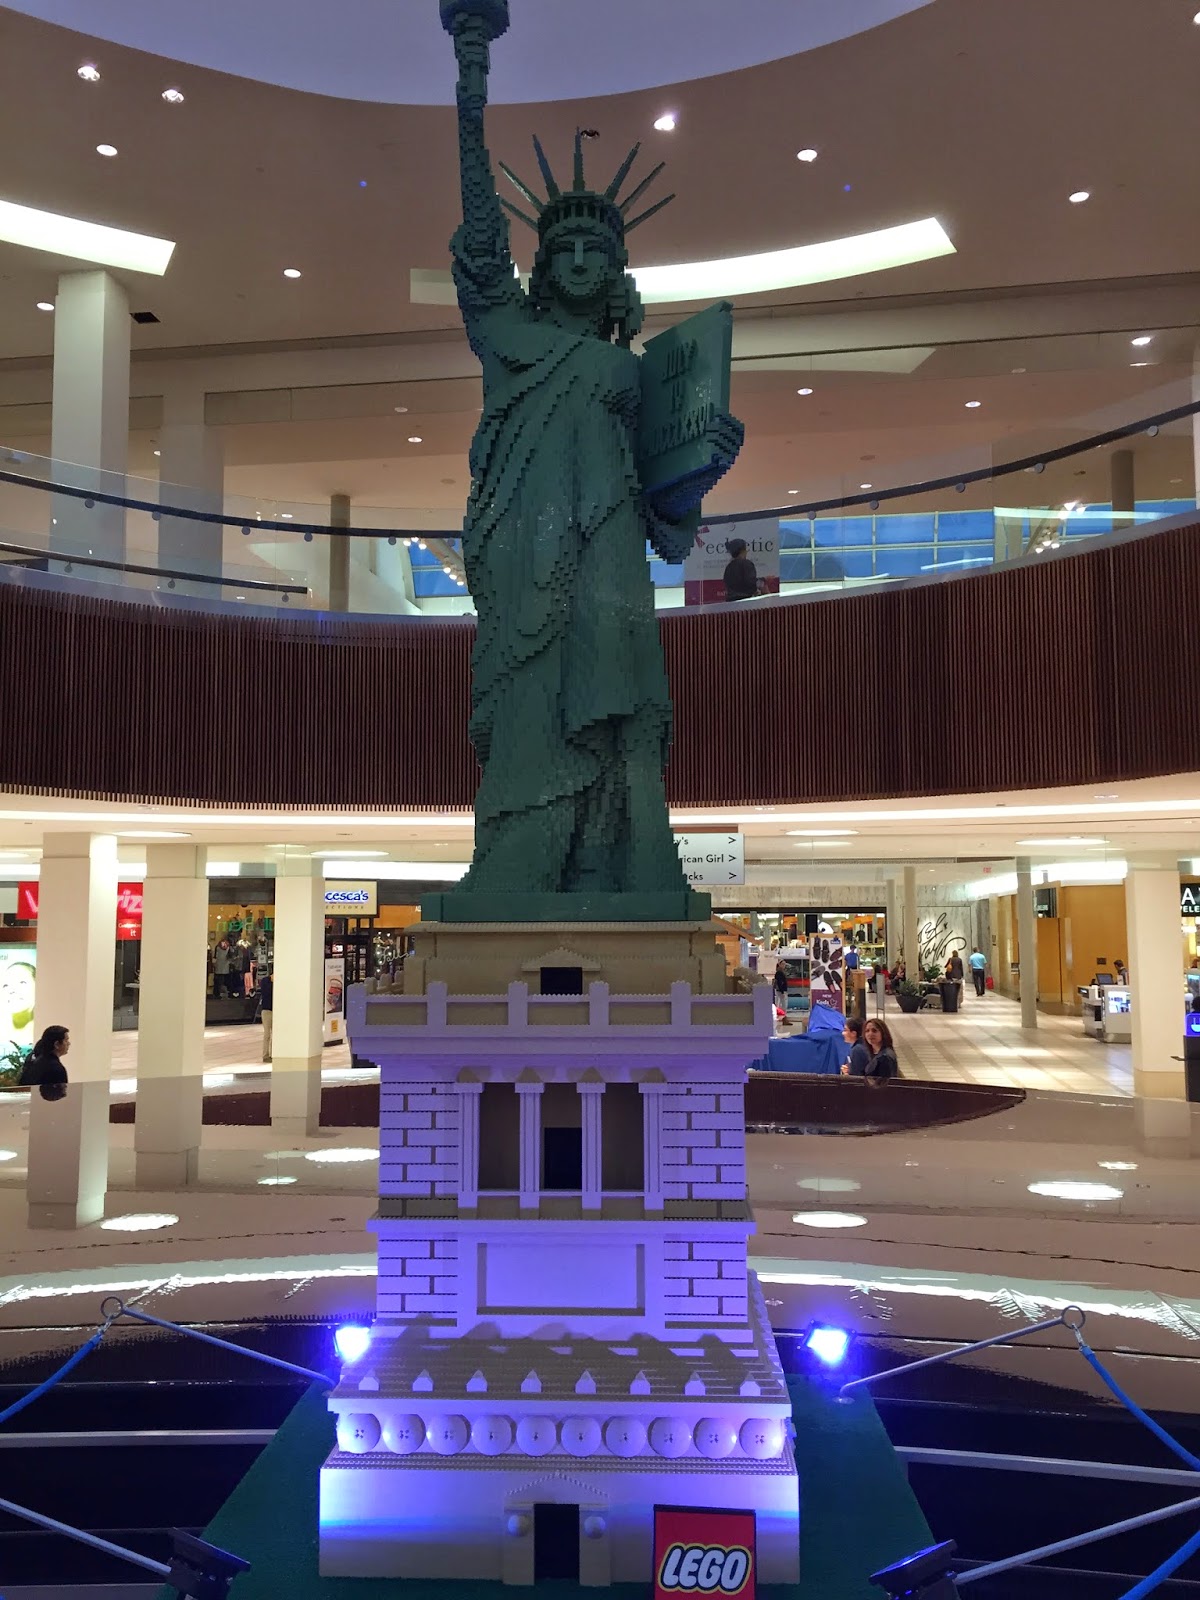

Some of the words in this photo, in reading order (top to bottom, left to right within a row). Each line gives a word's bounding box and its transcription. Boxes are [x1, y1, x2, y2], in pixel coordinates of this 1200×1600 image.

[706, 854, 724, 863] Girl
[688, 872, 704, 881] cks
[325, 890, 369, 901] cesca's
[661, 1545, 749, 1593] LEGO
